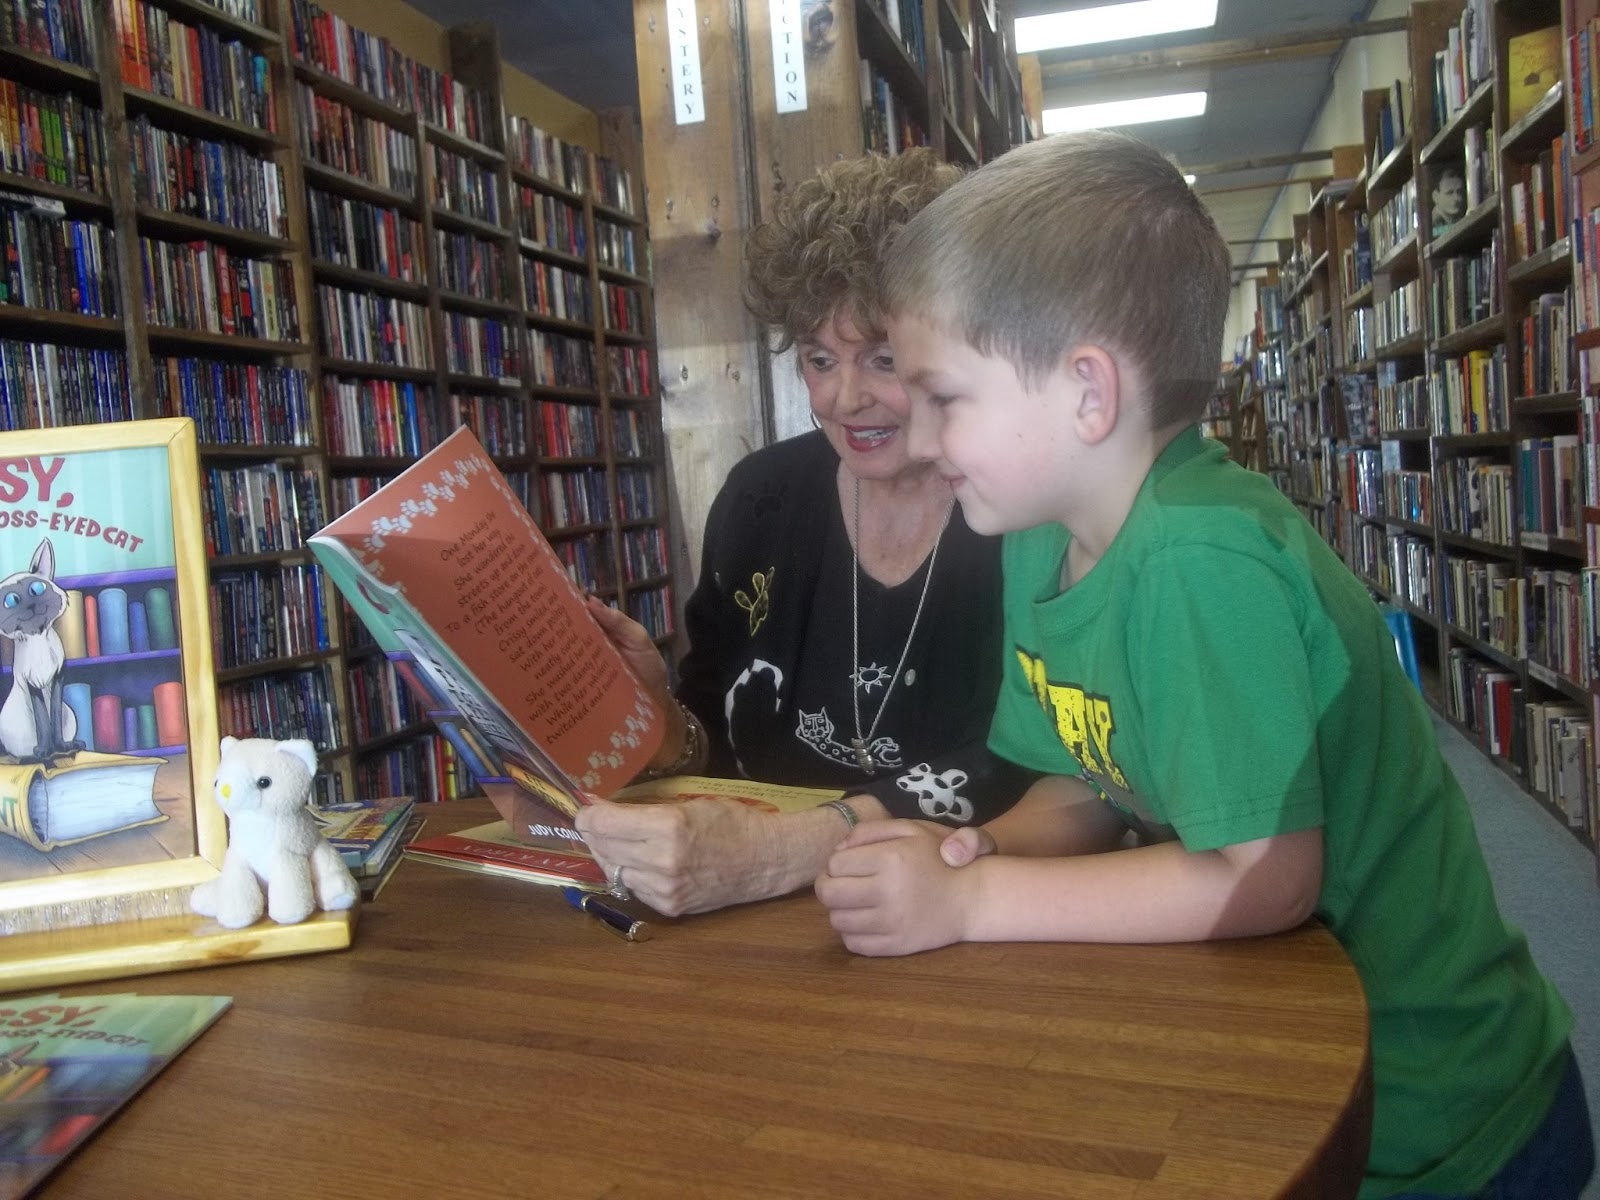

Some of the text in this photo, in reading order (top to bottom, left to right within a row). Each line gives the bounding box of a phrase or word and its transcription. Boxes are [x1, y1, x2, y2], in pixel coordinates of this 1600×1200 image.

[440, 543, 460, 562] One
[458, 519, 489, 547] Monday
[471, 540, 487, 554] her
[453, 572, 473, 591] She
[456, 578, 490, 608] streets
[443, 621, 461, 637] To
[470, 598, 490, 617] fish
[493, 613, 519, 637] from
[517, 600, 532, 616] the
[498, 626, 527, 653] Crissy
[508, 645, 526, 664] sat
[525, 626, 548, 649] down
[519, 649, 545, 672] With
[541, 636, 556, 652] her
[524, 687, 545, 707] She
[545, 655, 576, 689] washed
[533, 653, 562, 681] neatly
[528, 699, 554, 722] with
[553, 682, 572, 702] two
[544, 701, 573, 726] While
[571, 686, 588, 703] her
[545, 703, 590, 746] twitched
[528, 823, 555, 837] JUDY
